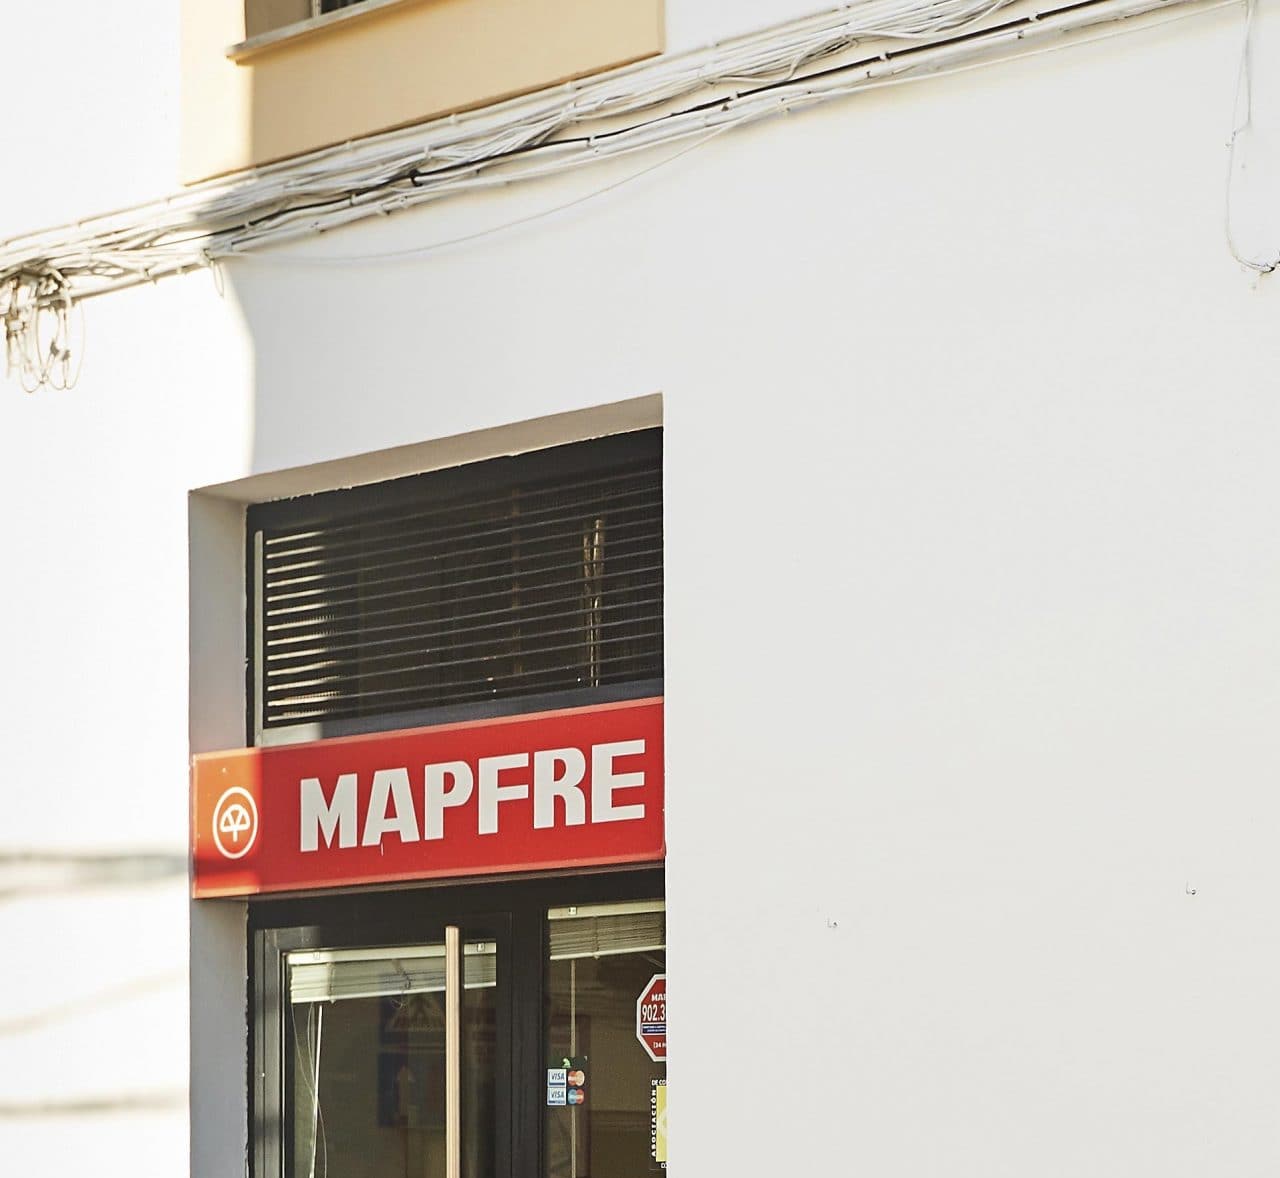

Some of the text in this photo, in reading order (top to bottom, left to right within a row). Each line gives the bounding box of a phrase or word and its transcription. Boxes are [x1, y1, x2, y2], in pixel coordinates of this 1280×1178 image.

[300, 739, 646, 852] MAPFRE
[551, 1072, 565, 1080] VISA
[551, 1090, 565, 1098] VISA
